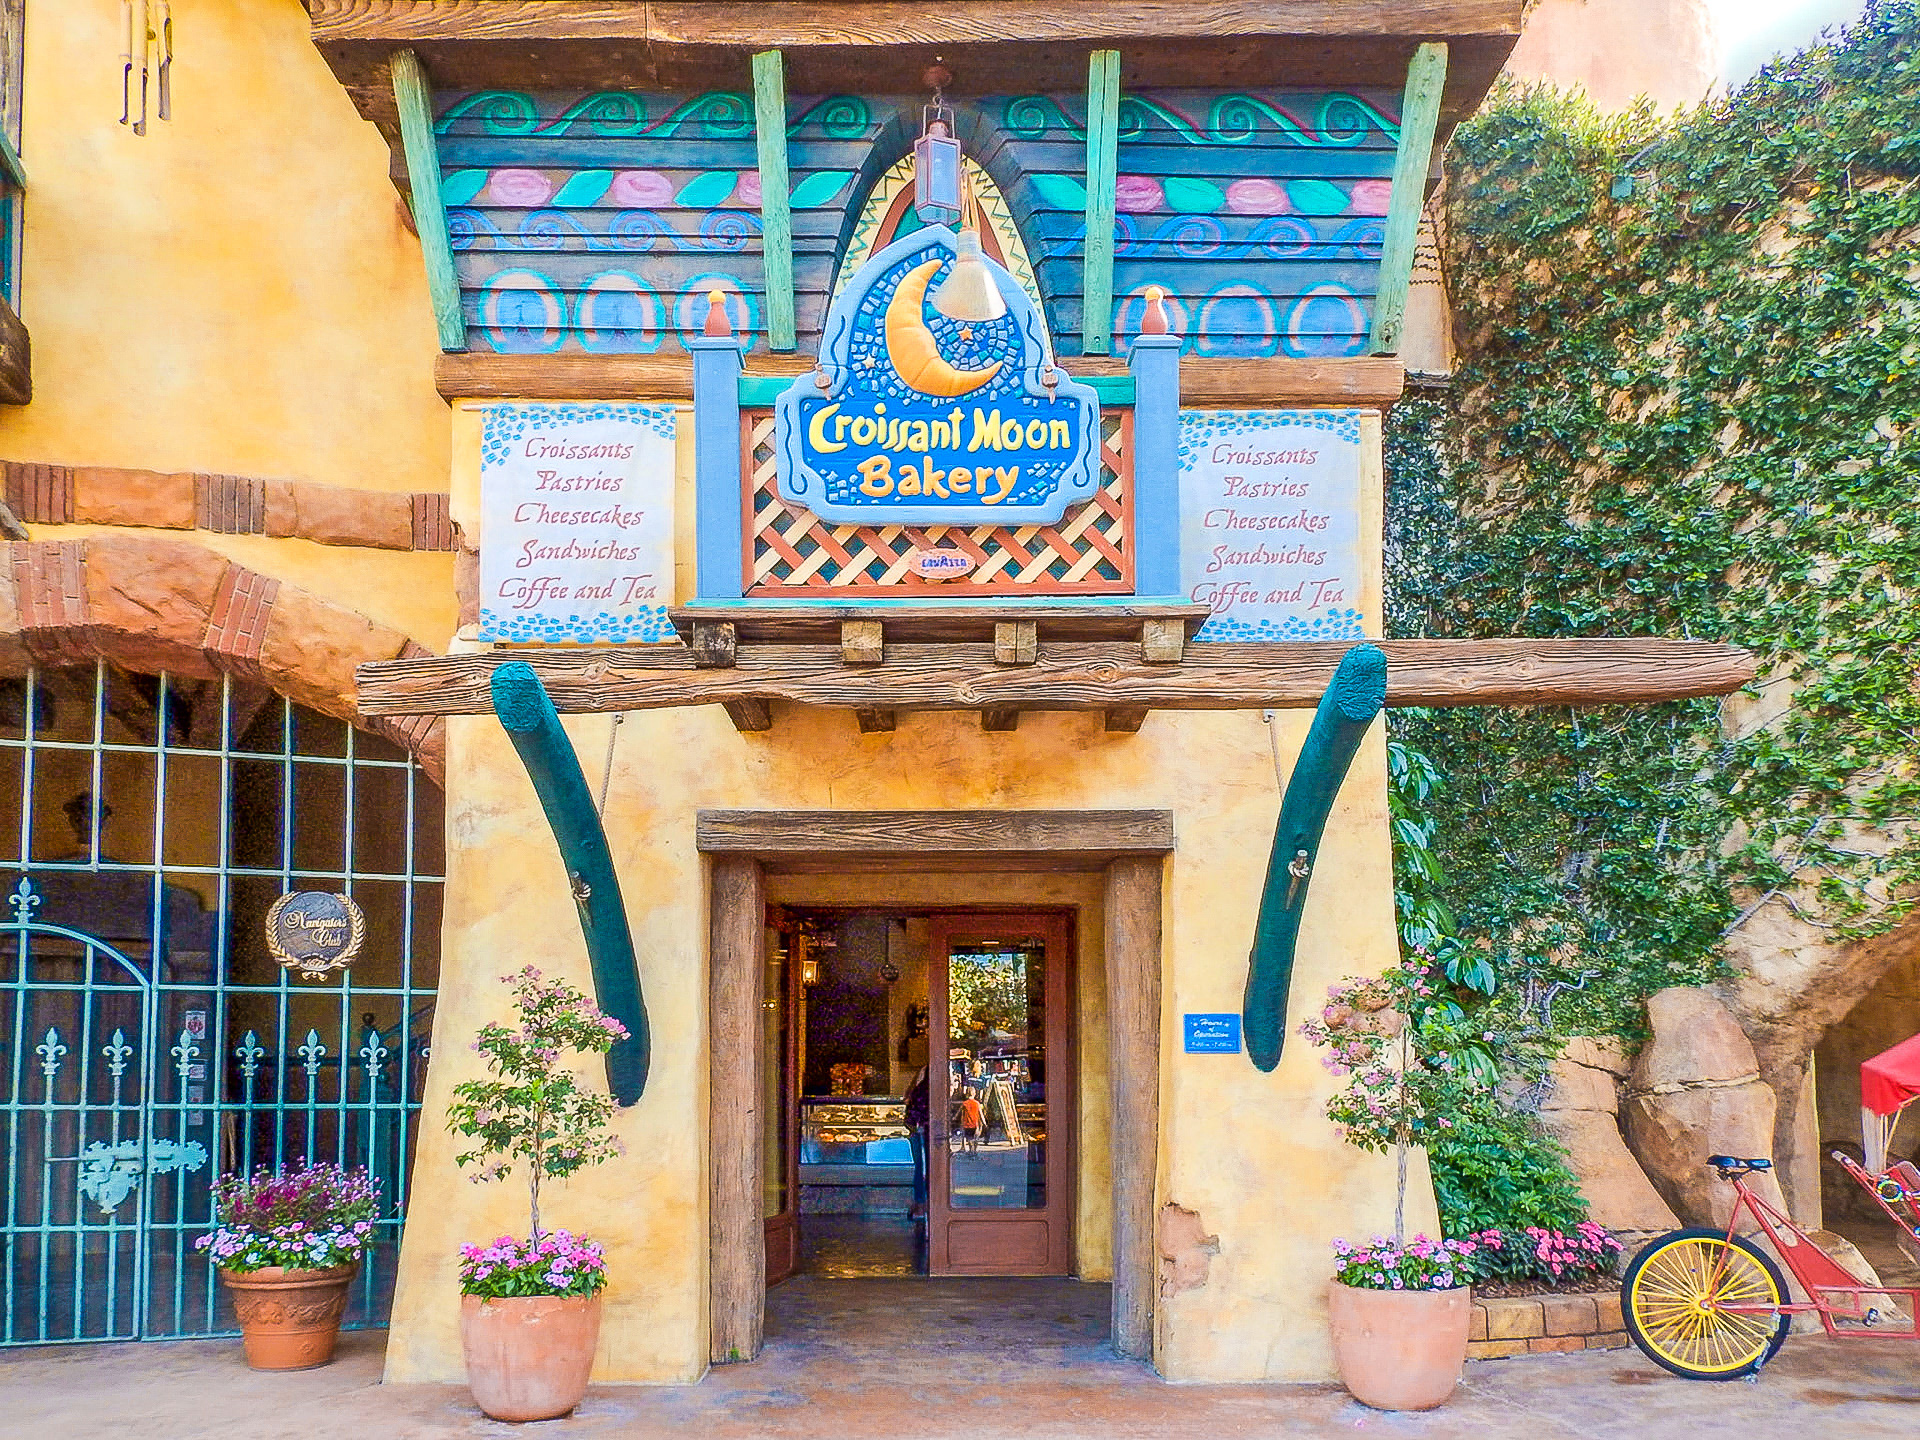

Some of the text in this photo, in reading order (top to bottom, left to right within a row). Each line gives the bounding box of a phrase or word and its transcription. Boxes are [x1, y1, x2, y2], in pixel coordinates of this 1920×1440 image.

[808, 403, 1070, 454] Croissant Moon
[525, 437, 634, 459] Croissants
[1212, 444, 1319, 465] Croissants
[535, 470, 623, 492] Pastries
[857, 455, 1019, 505] Bakery
[1223, 476, 1309, 498] Pastries
[514, 502, 644, 529] Cheesecakes
[1204, 509, 1329, 532] Cheesecakes
[516, 538, 641, 568] Sandwiches
[1207, 544, 1327, 573] Sandwiches
[498, 574, 656, 609] Coffee and Tea
[1190, 578, 1345, 613] Coffee and Tea
[312, 929, 341, 947] Club
